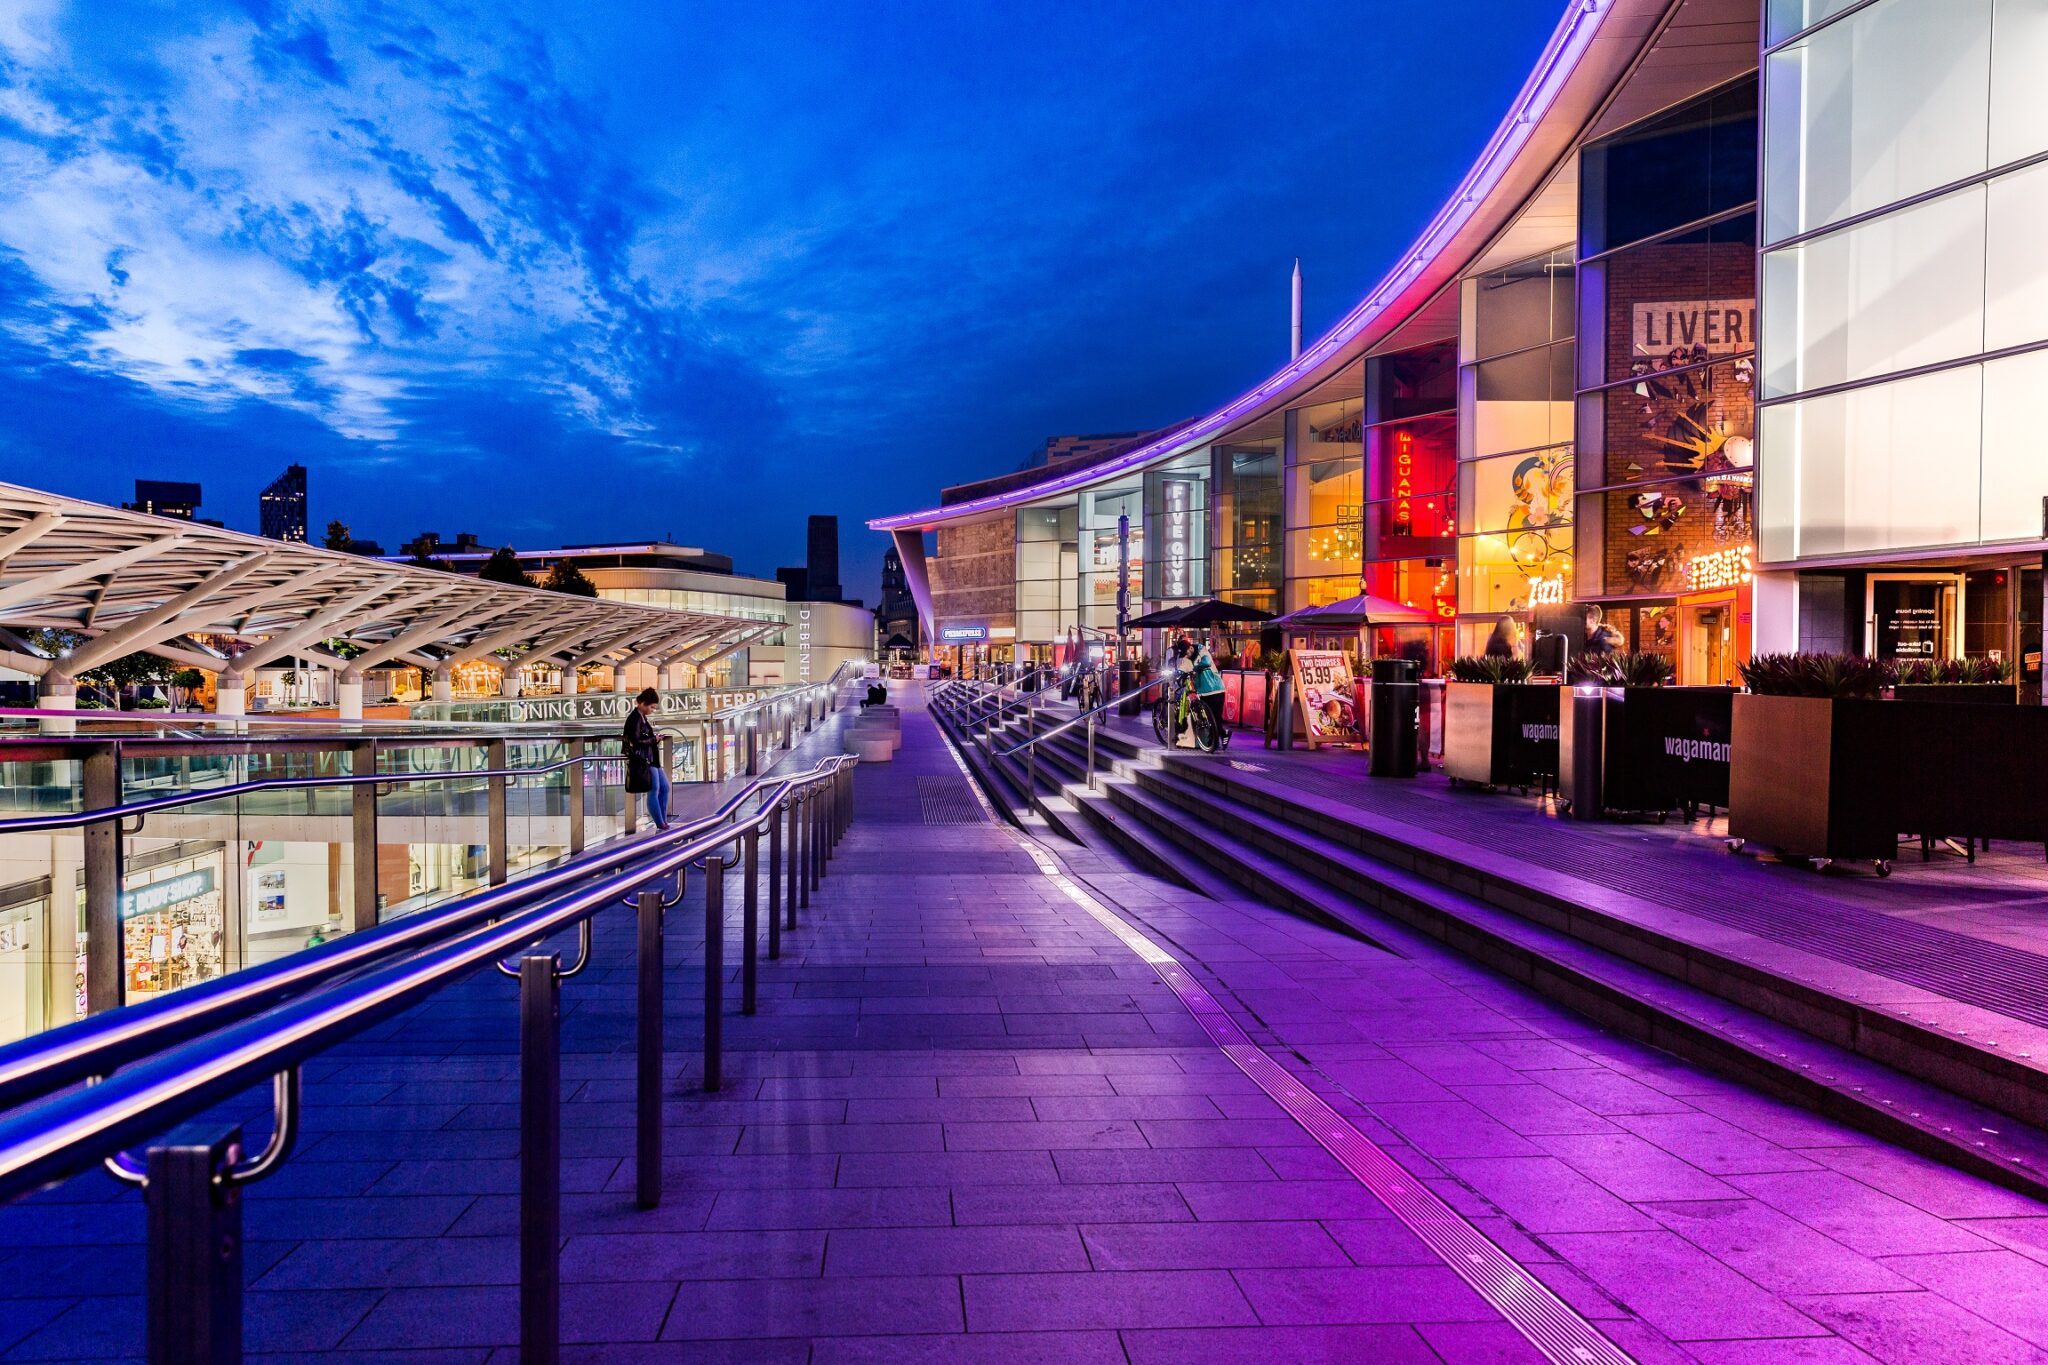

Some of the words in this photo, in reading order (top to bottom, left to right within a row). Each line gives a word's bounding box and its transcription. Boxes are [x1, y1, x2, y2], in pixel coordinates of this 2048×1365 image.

[1172, 485, 1184, 539] FIVE
[1171, 541, 1185, 596] GUYS
[1300, 659, 1314, 668] TWO
[1314, 658, 1341, 667] COURSES
[509, 701, 577, 721] DINING
[582, 700, 595, 716] &
[661, 696, 689, 713] ON
[1521, 723, 1559, 743] wagama
